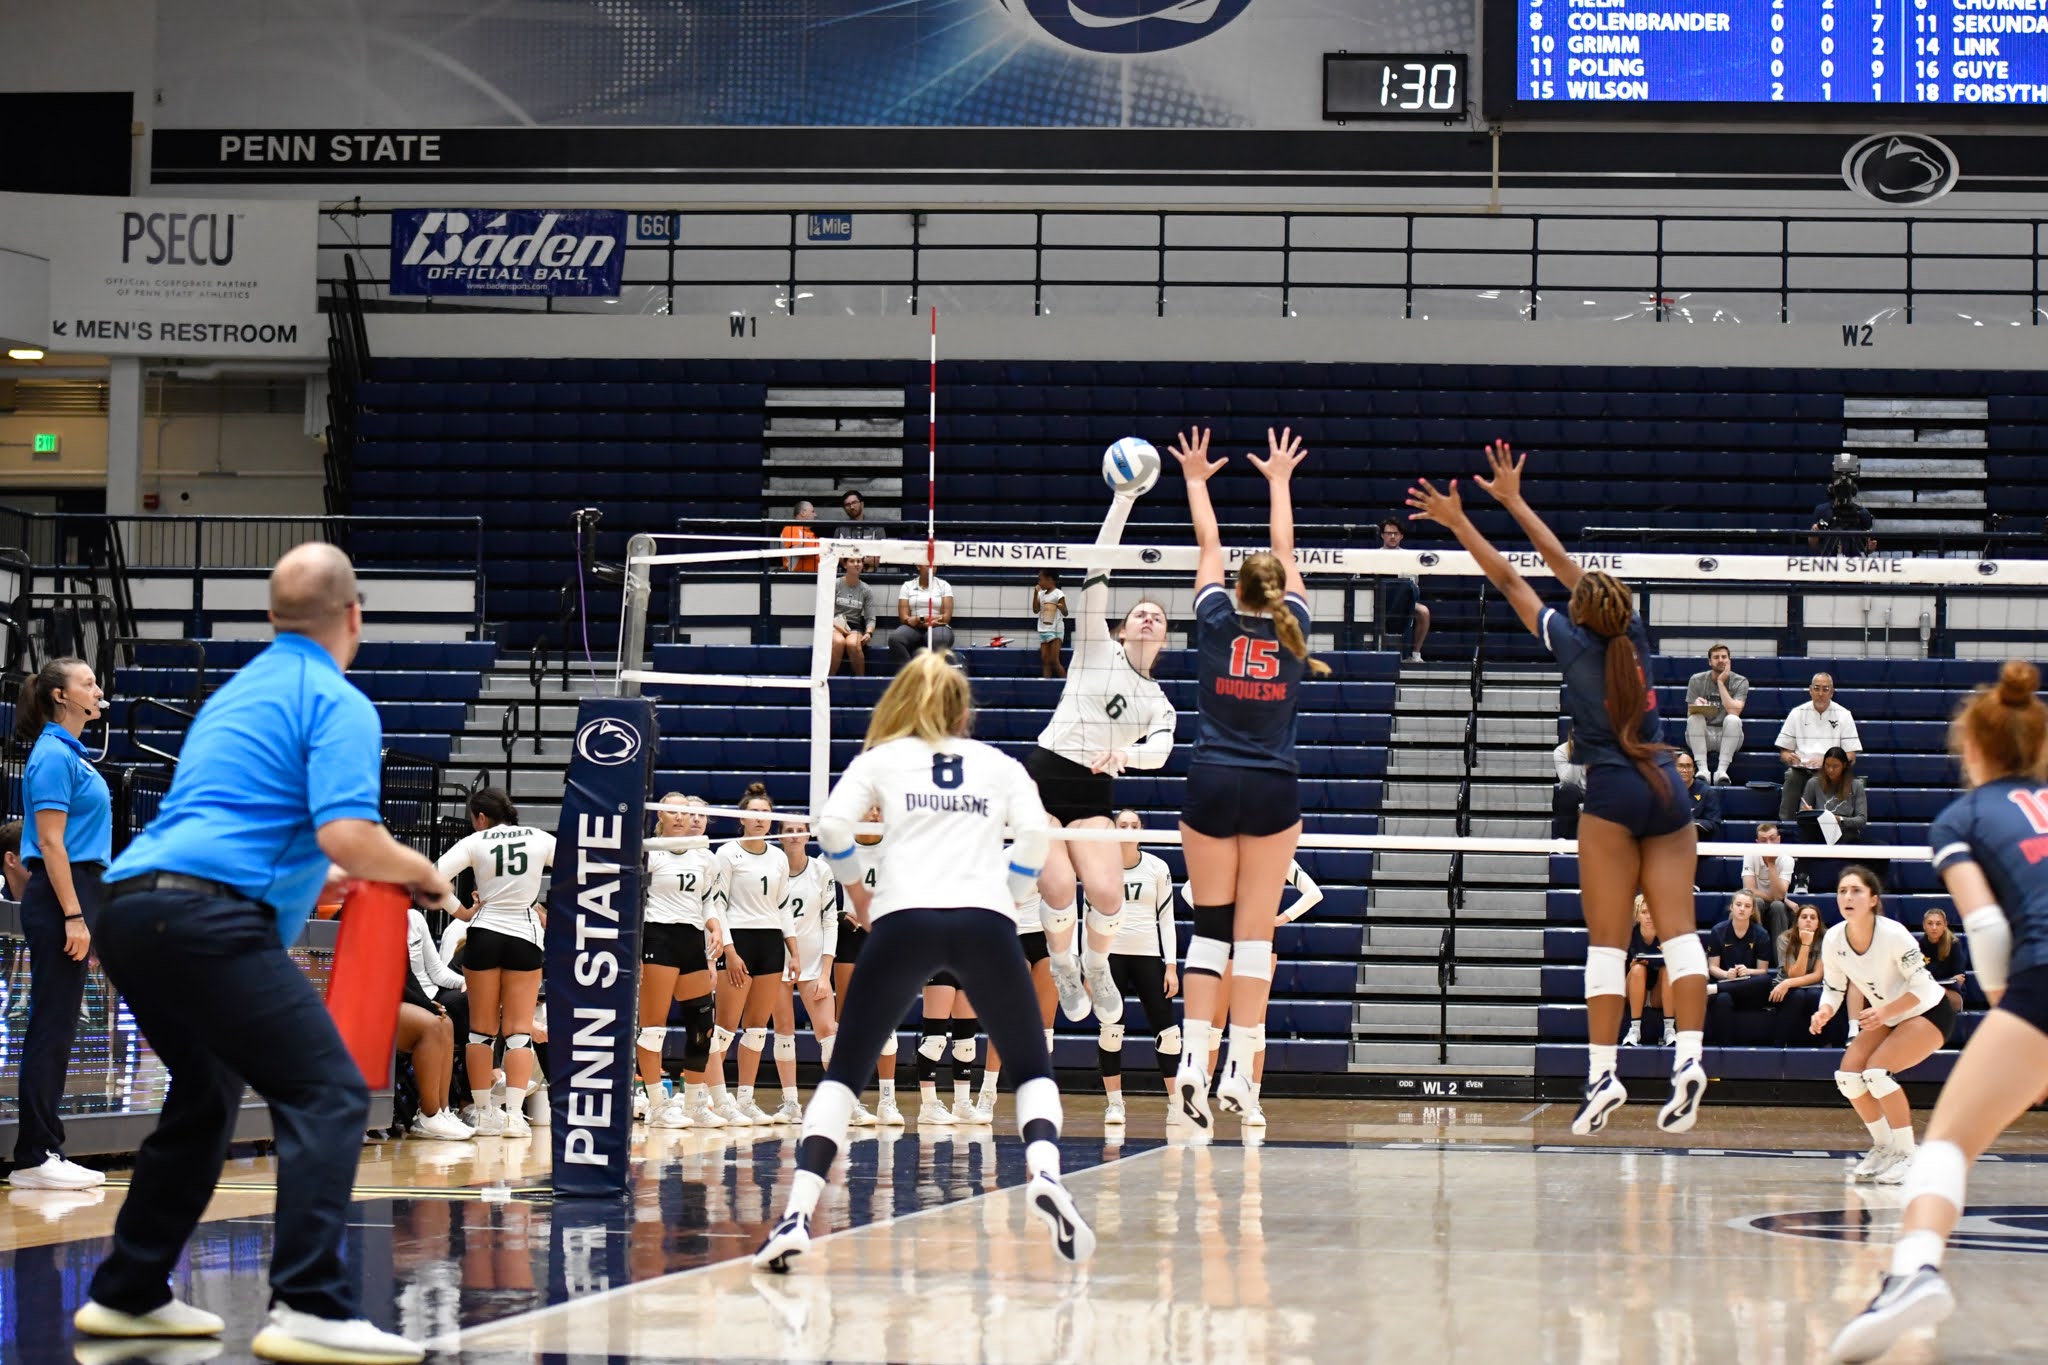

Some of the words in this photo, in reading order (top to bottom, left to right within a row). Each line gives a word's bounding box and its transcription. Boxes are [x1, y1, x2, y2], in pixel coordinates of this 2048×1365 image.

[1530, 12, 1543, 31] 8
[1568, 12, 1730, 31] COLENBRANDER
[1771, 13, 1784, 32] 0
[1821, 13, 1834, 32] 0
[1871, 14, 1884, 32] 7
[1916, 14, 1937, 33] 11
[1953, 15, 2048, 34] SEKUNDA
[1531, 35, 1554, 54] 10
[1568, 35, 1640, 54] GRIMM
[1771, 36, 1784, 55] 0
[1821, 36, 1834, 55] 0
[1872, 37, 1884, 55] 2
[1915, 37, 1940, 56] 14
[1953, 37, 2000, 56] LINK
[1531, 58, 1552, 77] 11
[1568, 58, 1645, 77] POLING
[1771, 59, 1784, 78] 0
[1821, 59, 1834, 78] 0
[1871, 60, 1884, 78] 9
[1915, 60, 1939, 79] 16
[1953, 60, 2009, 79] GUYE
[1381, 63, 1457, 110] 1:30
[1530, 81, 1554, 99] 15
[1567, 81, 1648, 100] WILSON
[1771, 82, 1784, 101] 2
[1822, 82, 1831, 101] 1
[1872, 82, 1882, 101] 1
[1915, 83, 1939, 101] 18
[1953, 83, 2048, 103] FORSYTH
[220, 135, 316, 162] PENN
[330, 135, 441, 162] STATE
[823, 218, 850, 234] Mile
[122, 211, 235, 266] PSECU
[427, 267, 524, 280] OFFICIAL
[533, 268, 588, 281] BALL
[217, 281, 258, 289] PARTNER
[76, 320, 153, 340] MEN'S
[160, 322, 298, 344] RESTROOM
[1842, 325, 1873, 347] W2
[35, 433, 56, 452] EXIT
[953, 543, 1004, 559] PENN
[1011, 544, 1067, 560] STATE
[1787, 558, 1838, 572] PENN
[1845, 558, 1903, 573] STATE
[1229, 635, 1280, 680] 15
[1215, 676, 1287, 701] DUQUESNE
[1106, 693, 1127, 720] 6
[932, 752, 964, 790] 8
[905, 793, 988, 818] DUQUESNE
[482, 828, 534, 840] LOYOLA
[489, 841, 528, 877] 15
[676, 872, 697, 893] 12
[760, 875, 768, 896] 1
[865, 867, 877, 888] 4
[574, 813, 623, 989] STATE
[1124, 882, 1143, 901] 17
[791, 898, 804, 918] 2
[564, 1007, 617, 1166] PENN
[1399, 1080, 1414, 1088] ODD
[1423, 1081, 1445, 1095] WL
[1448, 1082, 1457, 1095] 2
[1466, 1080, 1484, 1088] EVEN
